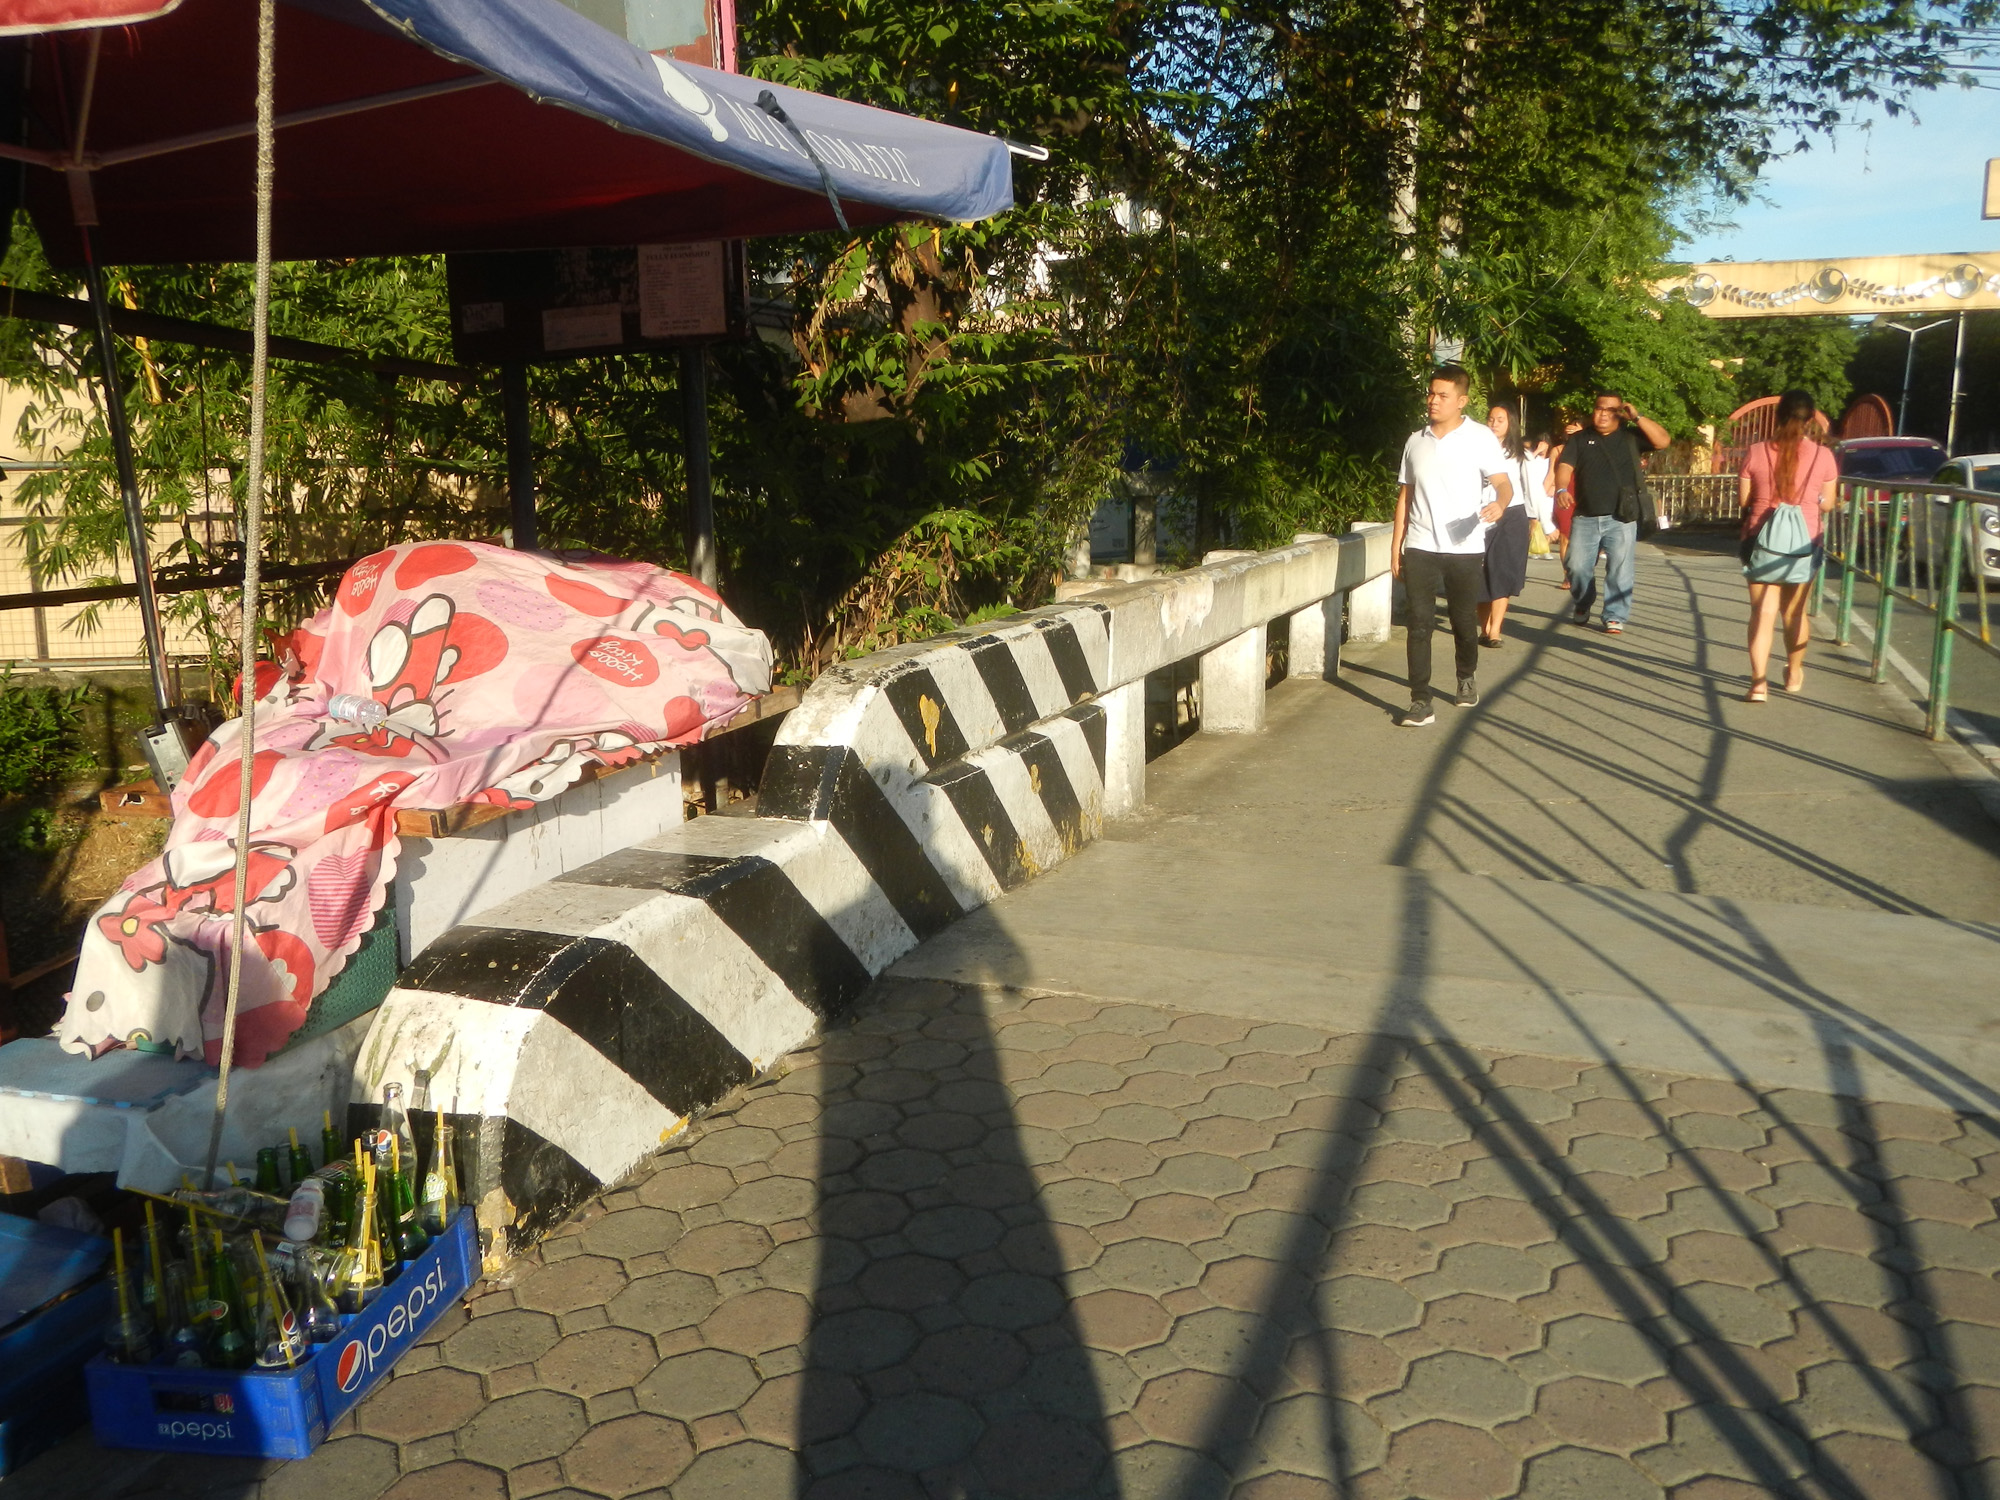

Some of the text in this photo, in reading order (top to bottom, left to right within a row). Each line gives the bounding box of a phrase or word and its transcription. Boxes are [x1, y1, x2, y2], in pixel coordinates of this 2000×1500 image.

[588, 650, 644, 682] Hello
[596, 640, 644, 667] Kitty
[367, 1257, 445, 1373] pepsi
[171, 1421, 233, 1441] pepsi
